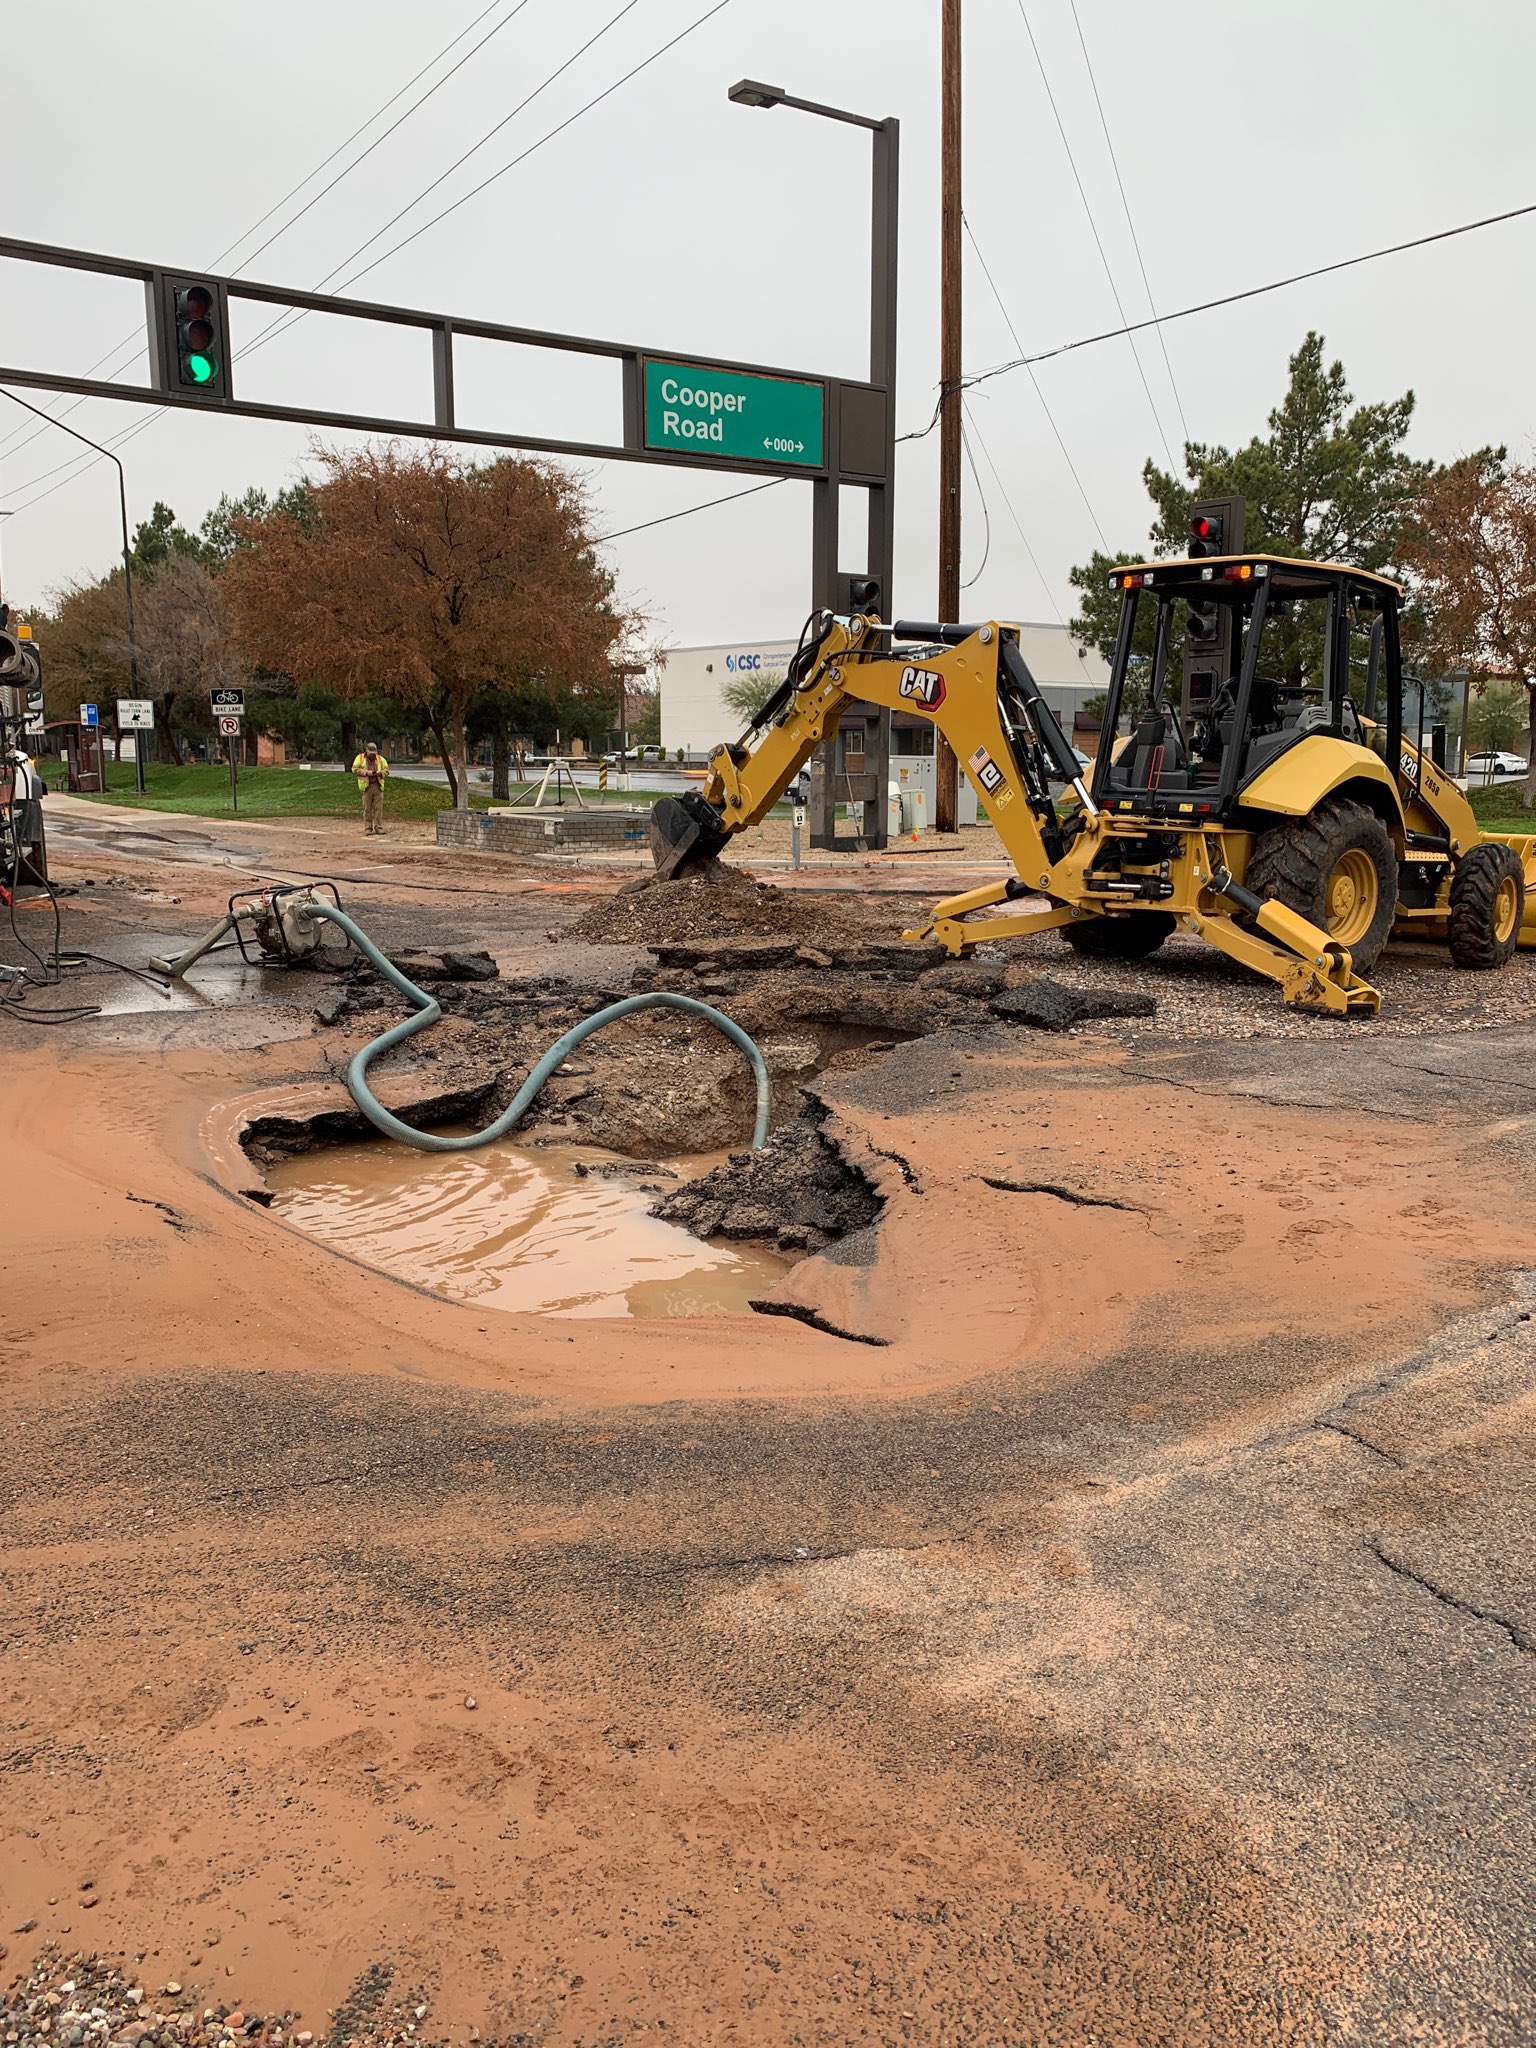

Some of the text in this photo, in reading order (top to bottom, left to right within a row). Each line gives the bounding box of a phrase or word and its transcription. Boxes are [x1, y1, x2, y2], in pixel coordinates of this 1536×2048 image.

[661, 379, 746, 415] Cooper
[663, 411, 723, 442] Road
[773, 437, 795, 453] 000
[738, 654, 761, 670] CSC
[899, 667, 939, 702] CAT
[1400, 753, 1418, 779] 420
[1424, 775, 1440, 797] 2858
